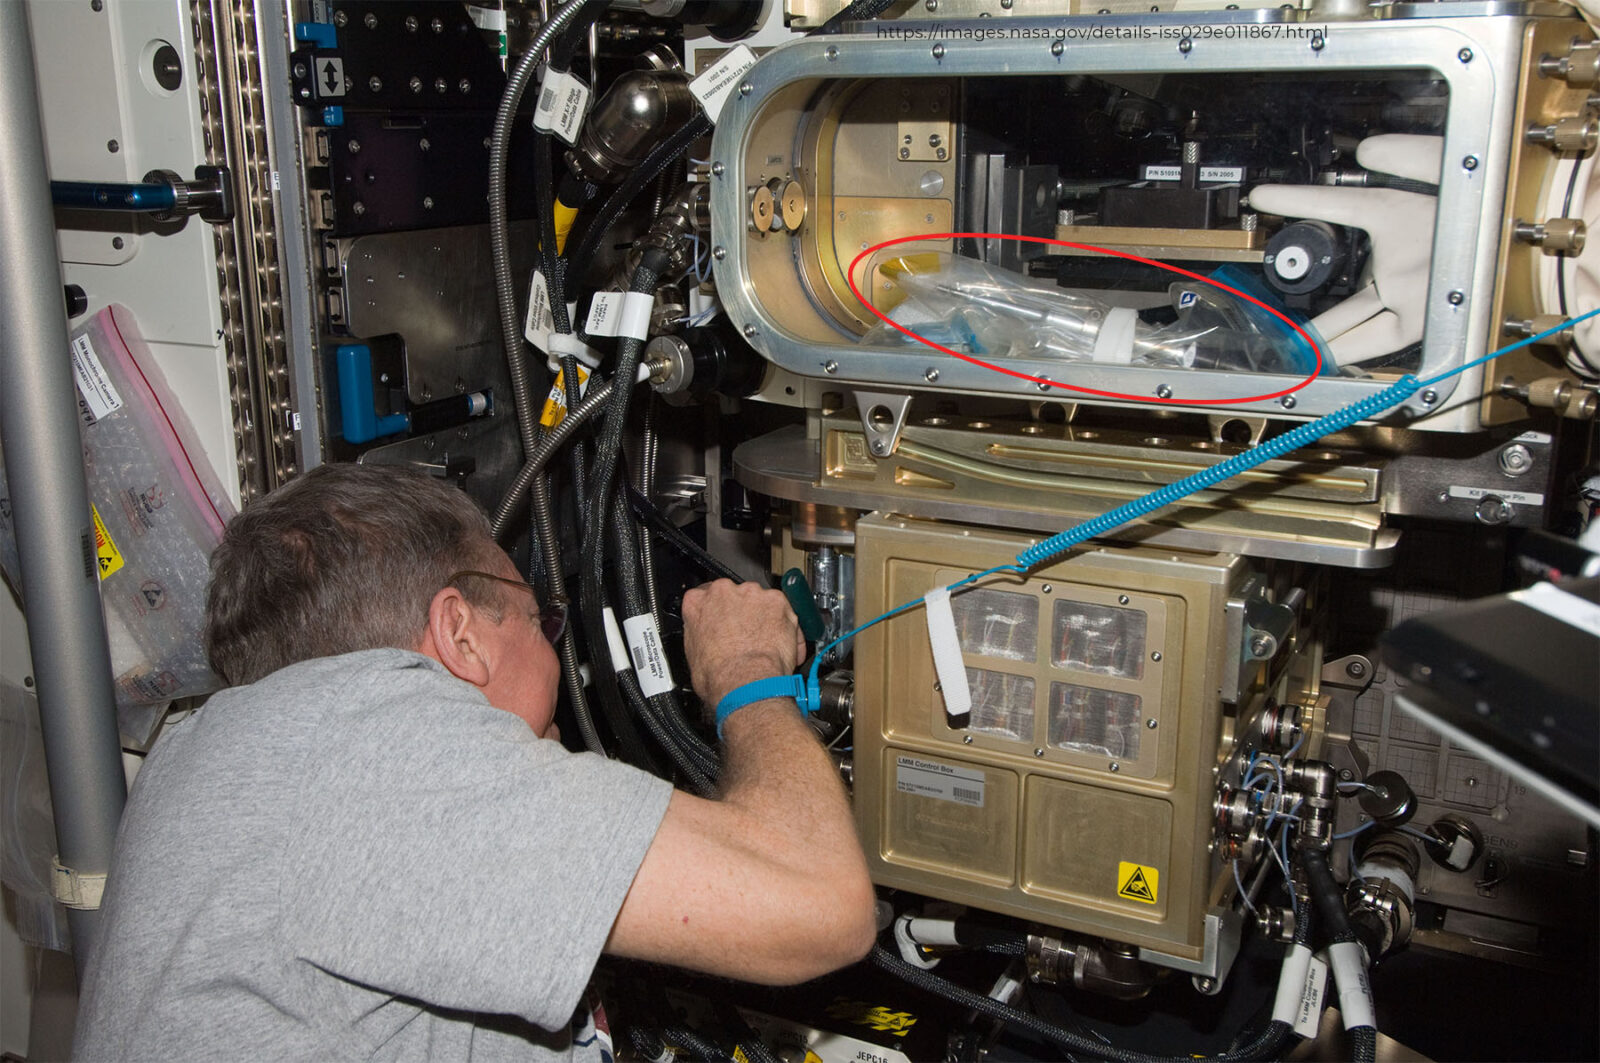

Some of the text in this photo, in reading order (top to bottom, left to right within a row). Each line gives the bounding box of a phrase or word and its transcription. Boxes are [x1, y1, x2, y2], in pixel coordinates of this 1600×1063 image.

[572, 88, 582, 104] Cable
[99, 383, 116, 405] Camera
[641, 630, 654, 662] Microscope
[647, 631, 656, 647] Cable
[898, 758, 914, 766] LMM
[915, 761, 940, 771] Control
[1305, 980, 1314, 1001] Control
